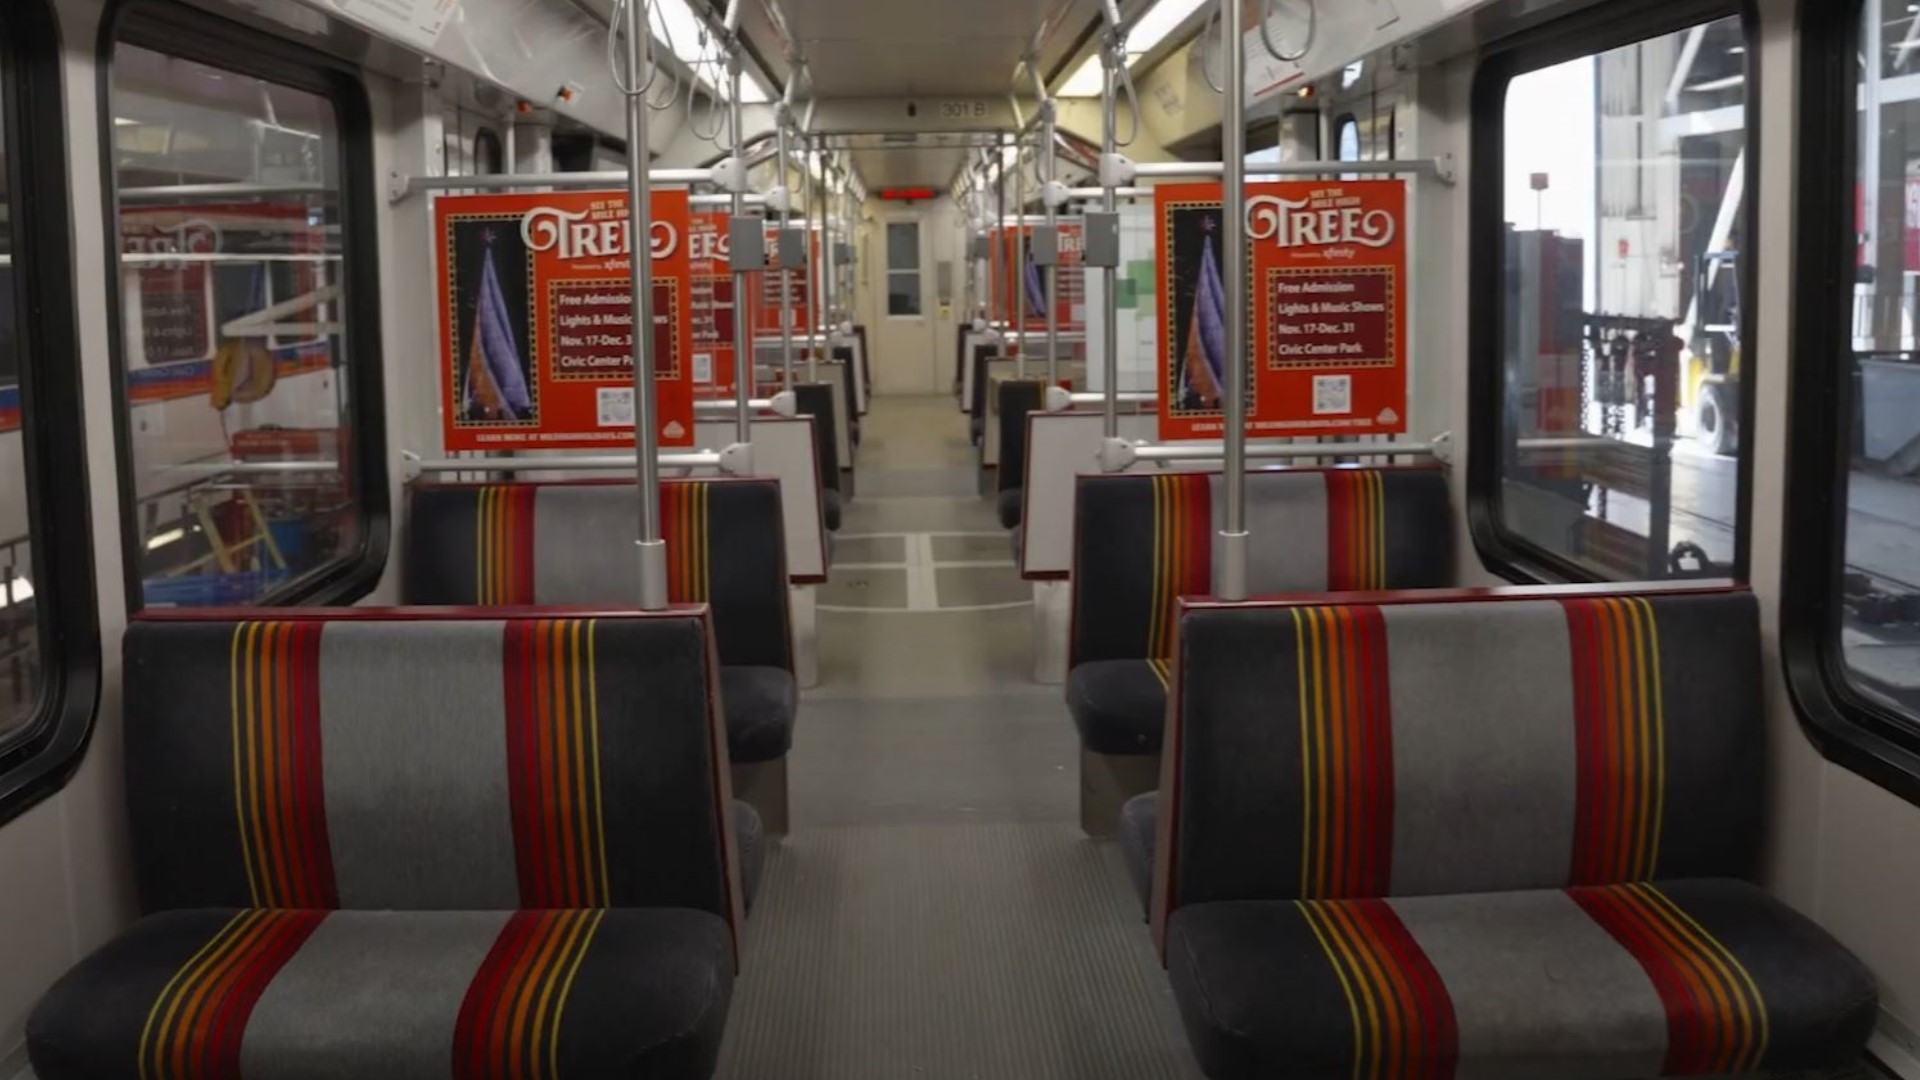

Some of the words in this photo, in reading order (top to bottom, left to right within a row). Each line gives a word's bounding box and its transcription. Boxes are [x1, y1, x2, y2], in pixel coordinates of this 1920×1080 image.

[943, 103, 969, 117] 301
[974, 102, 986, 117] B
[1244, 194, 1396, 248] TREE
[603, 258, 631, 271] xfinit
[1278, 282, 1300, 293] Free
[1302, 281, 1355, 293] Admission
[560, 295, 581, 305] Free
[583, 293, 632, 305] Admissio
[1278, 302, 1310, 317] Lights
[1320, 302, 1350, 313] Music
[1351, 301, 1385, 313] Shows
[560, 314, 592, 328] Lights
[593, 314, 601, 326] &
[603, 313, 633, 325] Music
[1278, 324, 1302, 335] Nov.
[1342, 322, 1355, 333] 31
[560, 335, 585, 346] Nov.
[1278, 343, 1304, 355] Civic
[1304, 343, 1338, 355] Center
[1339, 341, 1364, 353] Park
[561, 355, 586, 367] Civic
[588, 355, 621, 367] Center
[622, 354, 635, 366] Pa
